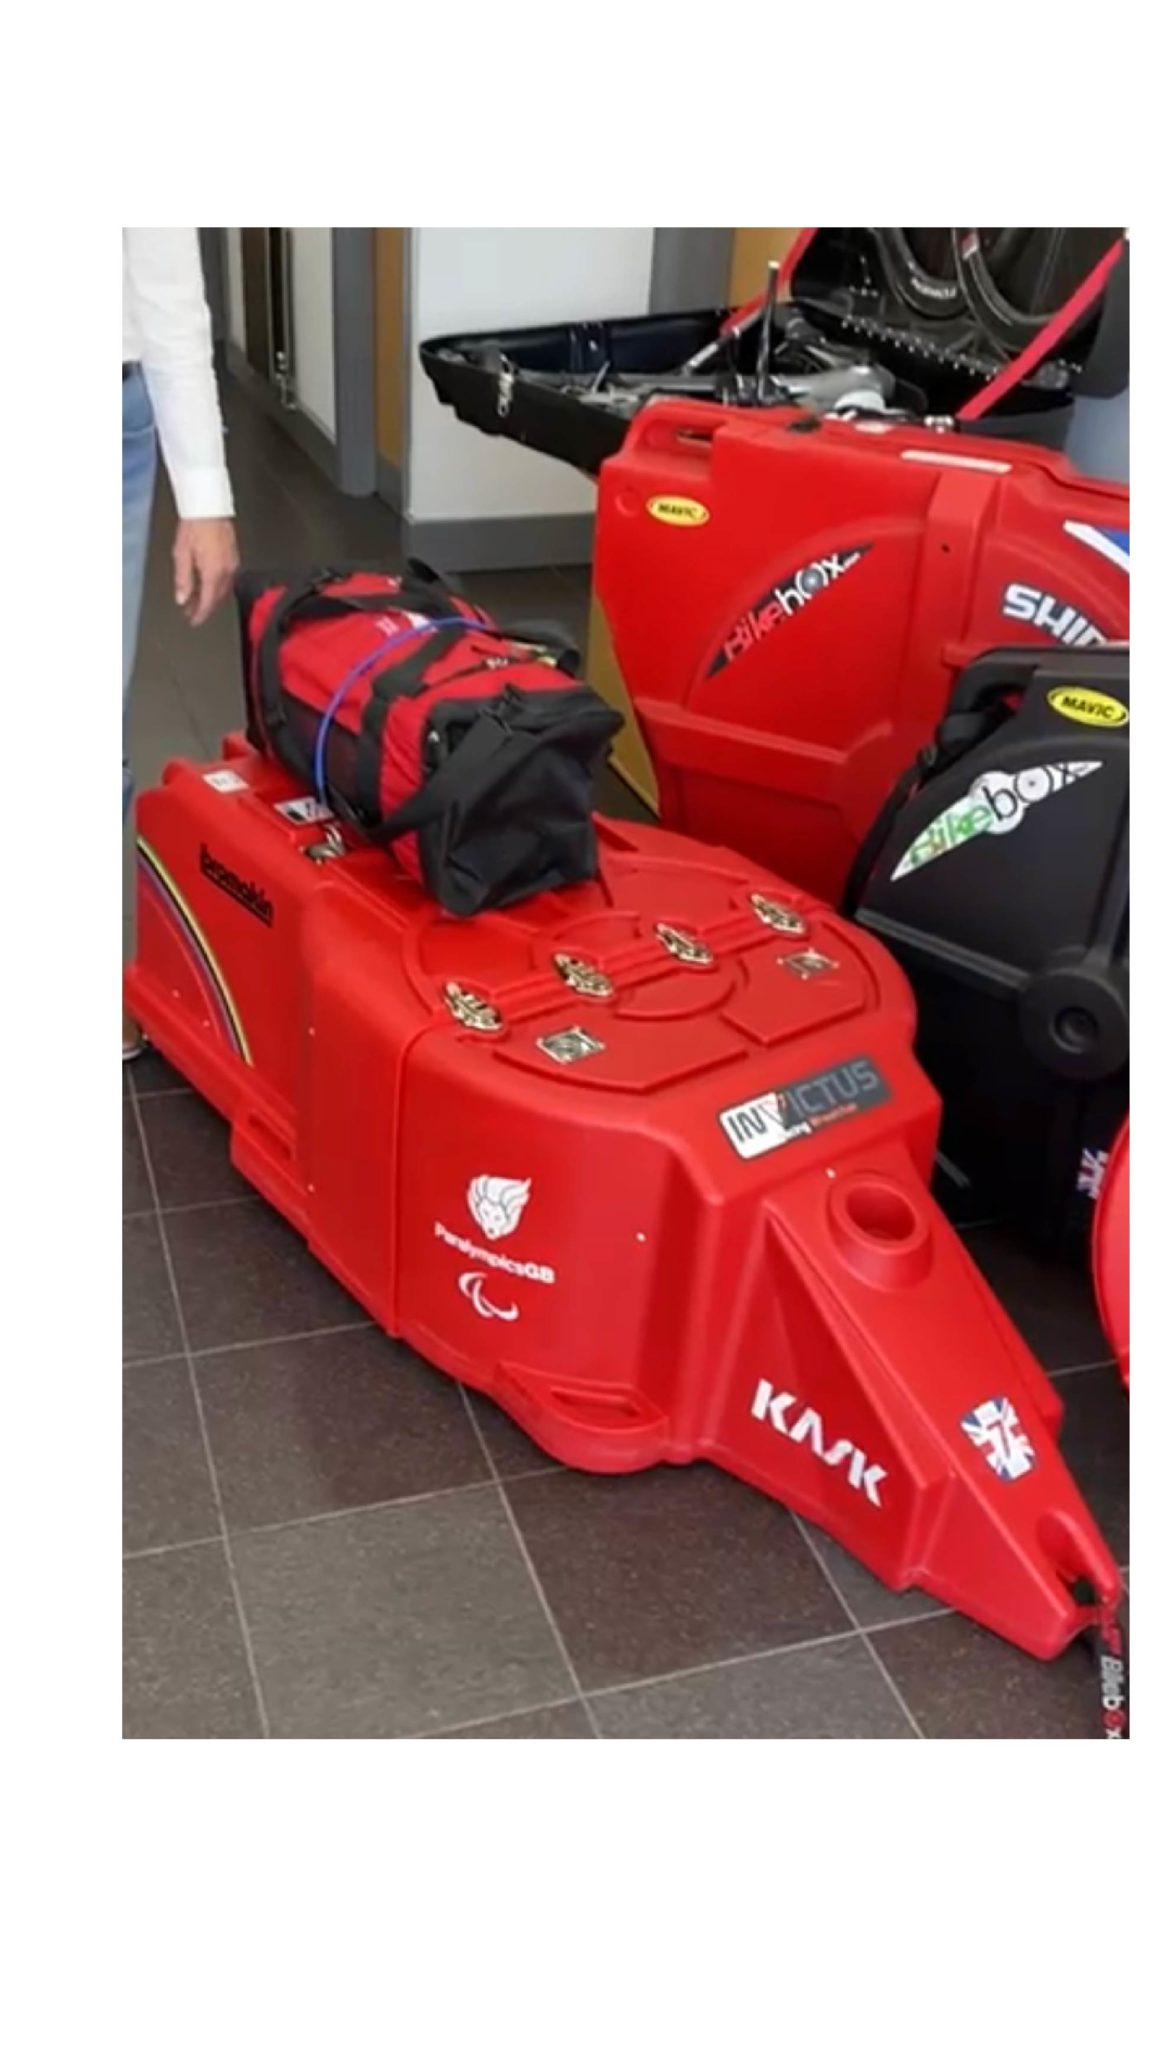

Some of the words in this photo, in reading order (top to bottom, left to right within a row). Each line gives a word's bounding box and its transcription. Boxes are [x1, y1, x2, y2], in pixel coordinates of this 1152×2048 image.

[1061, 695, 1115, 718] MAVIC
[727, 1059, 880, 1144] INVICTUS
[434, 1220, 556, 1285] ParalympicsGB
[751, 1378, 888, 1508] KASK
